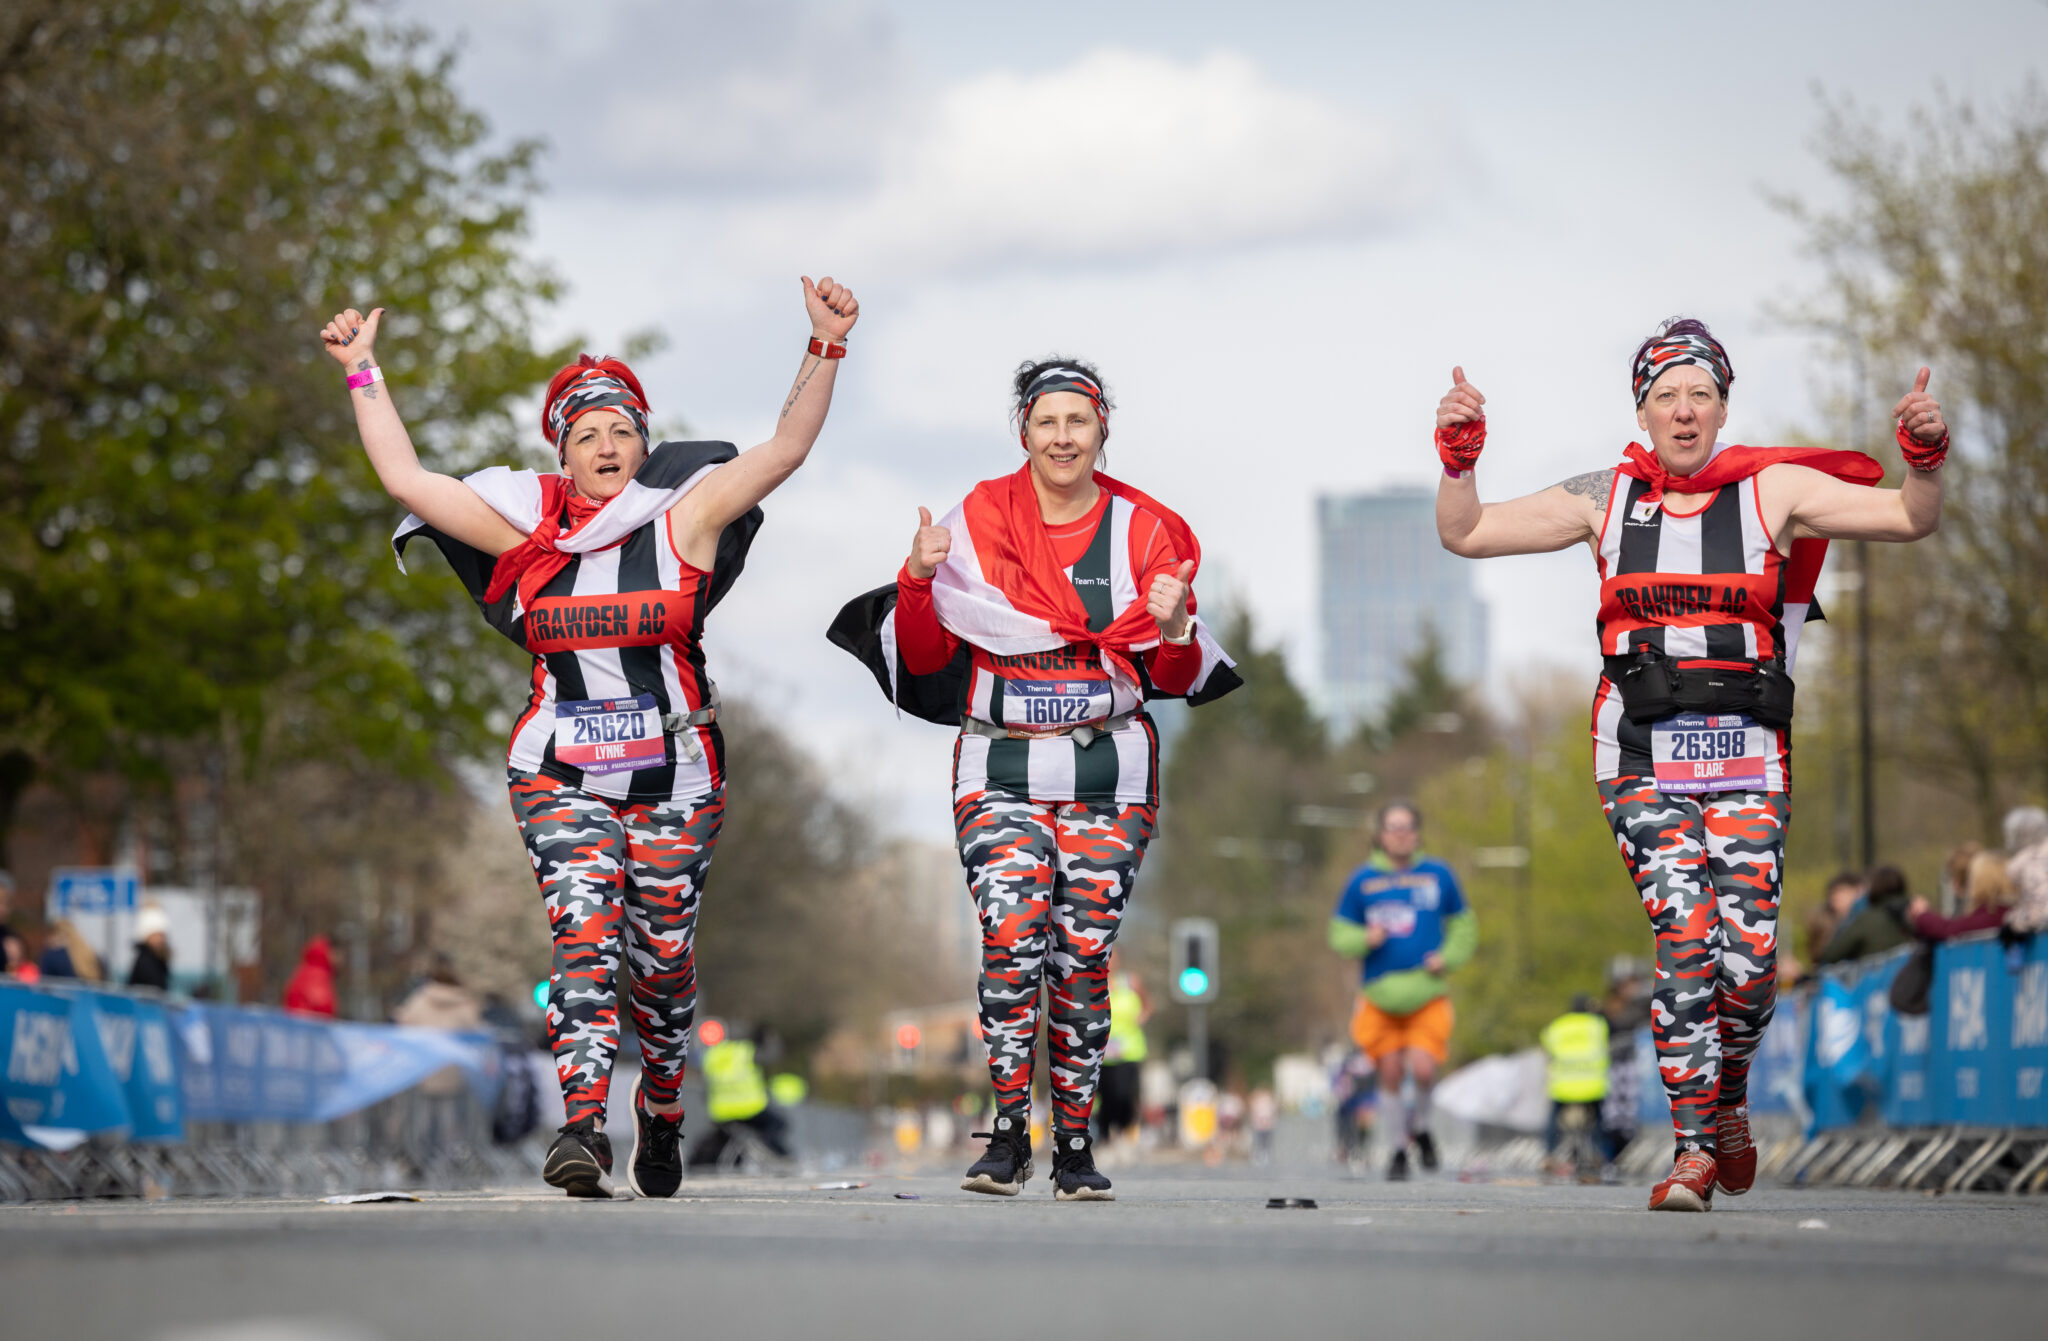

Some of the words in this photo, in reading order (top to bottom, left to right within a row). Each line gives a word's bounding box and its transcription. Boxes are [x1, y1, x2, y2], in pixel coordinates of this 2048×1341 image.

[1074, 577, 1095, 585] Team
[1096, 577, 1110, 586] TAC
[1616, 585, 1712, 620] TRAWDEN
[1719, 586, 1747, 614] AC
[529, 604, 628, 642] TRAWDEN
[638, 602, 666, 635] AC
[1085, 644, 1104, 671] A
[1026, 685, 1053, 693] Therme
[575, 705, 602, 713] Therme
[1024, 698, 1091, 724] 16022
[573, 712, 646, 744] 26620
[595, 743, 626, 760] LYNNE
[1671, 730, 1746, 761] 26398
[1694, 762, 1725, 778] CLARE
